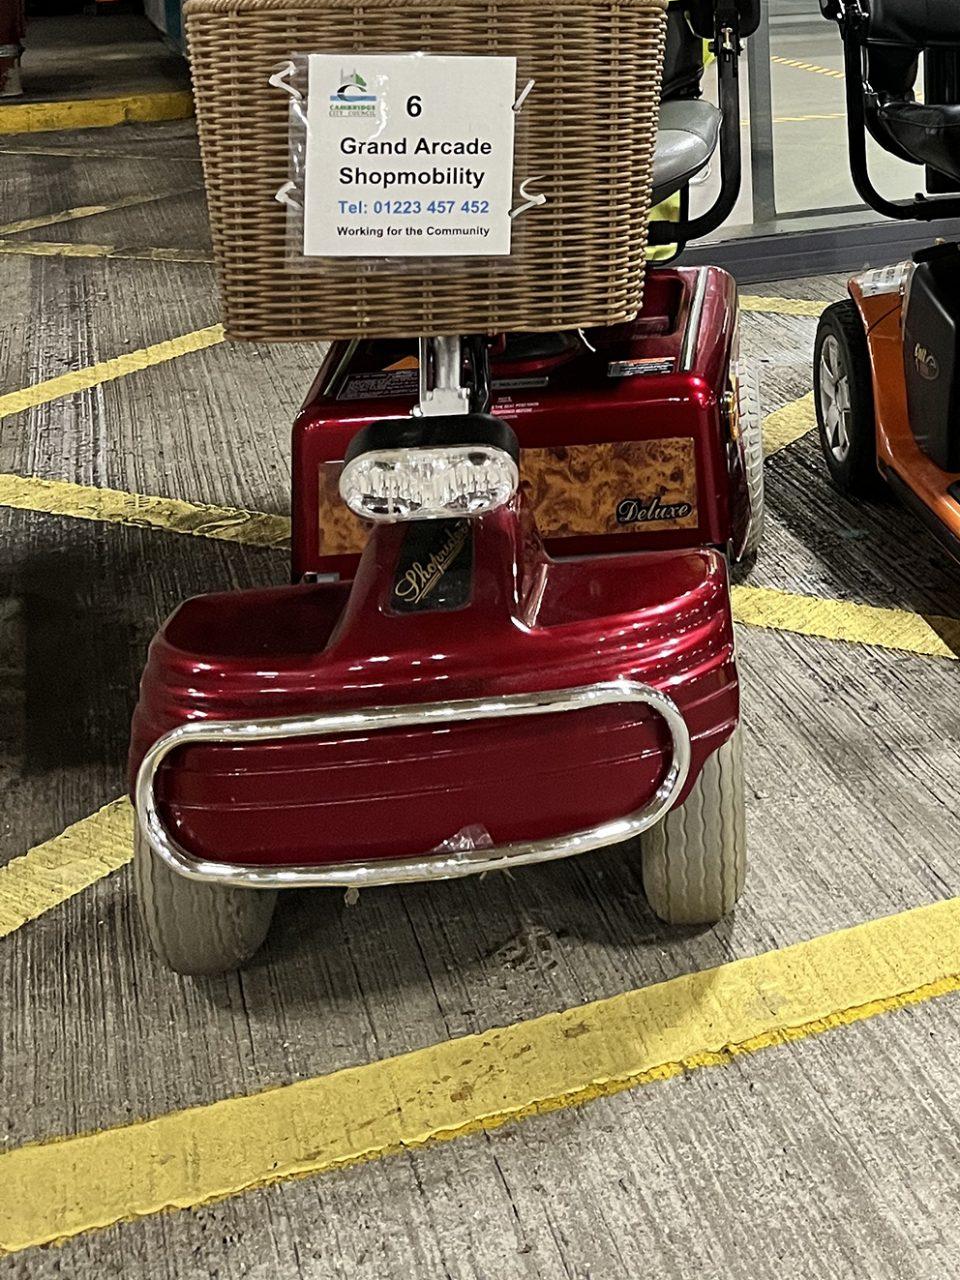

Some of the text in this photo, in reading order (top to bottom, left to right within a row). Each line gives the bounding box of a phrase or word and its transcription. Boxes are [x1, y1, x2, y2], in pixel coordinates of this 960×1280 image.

[406, 95, 423, 118] 6
[340, 137, 492, 155] Grand Arcade
[339, 167, 485, 189] Shopmobility
[338, 200, 490, 215] Tel: 01223 457 452
[337, 226, 490, 238] Working for the Community
[619, 499, 688, 520] Deluxe
